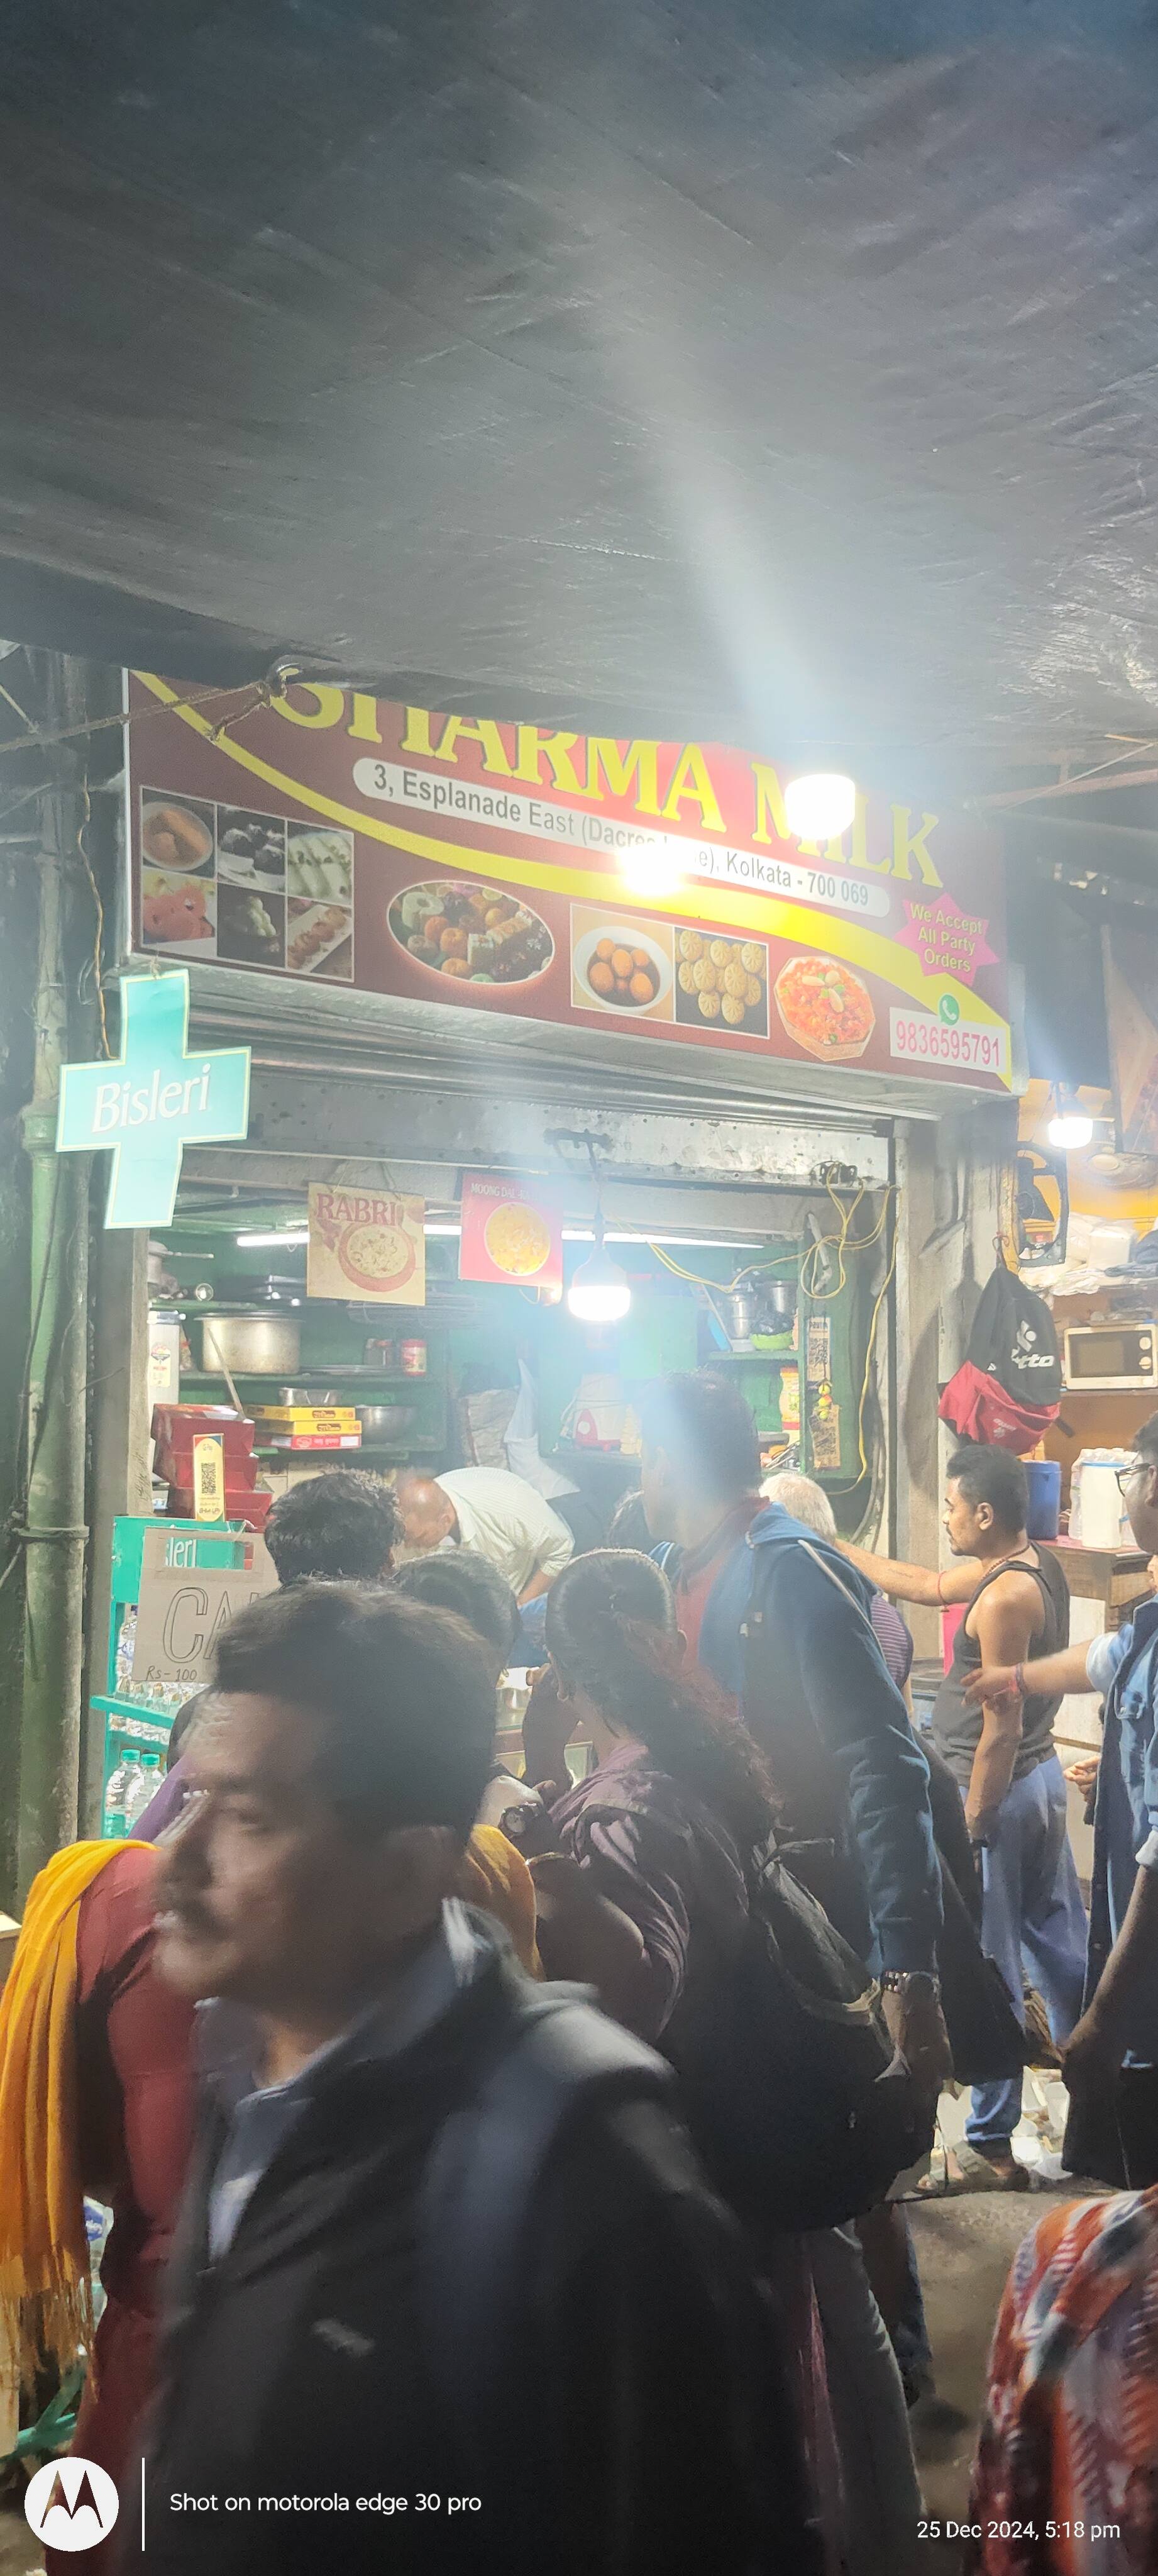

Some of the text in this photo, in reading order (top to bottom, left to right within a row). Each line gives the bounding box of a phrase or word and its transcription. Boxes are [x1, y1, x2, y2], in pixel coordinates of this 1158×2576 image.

[374, 763, 394, 797] 3,
[403, 769, 521, 823] Esplanade
[529, 802, 575, 836] East
[727, 851, 791, 888] Kolkata
[807, 871, 836, 899] 700
[841, 880, 869, 906] 069
[910, 903, 983, 936] We Accept
[918, 927, 976, 957] All Party
[924, 948, 971, 973] Orders
[896, 1019, 1000, 1067] 9836595791
[91, 1063, 212, 1133] Bisleri
[470, 1182, 500, 1197] MOONG
[316, 1192, 399, 1227] RABRI
